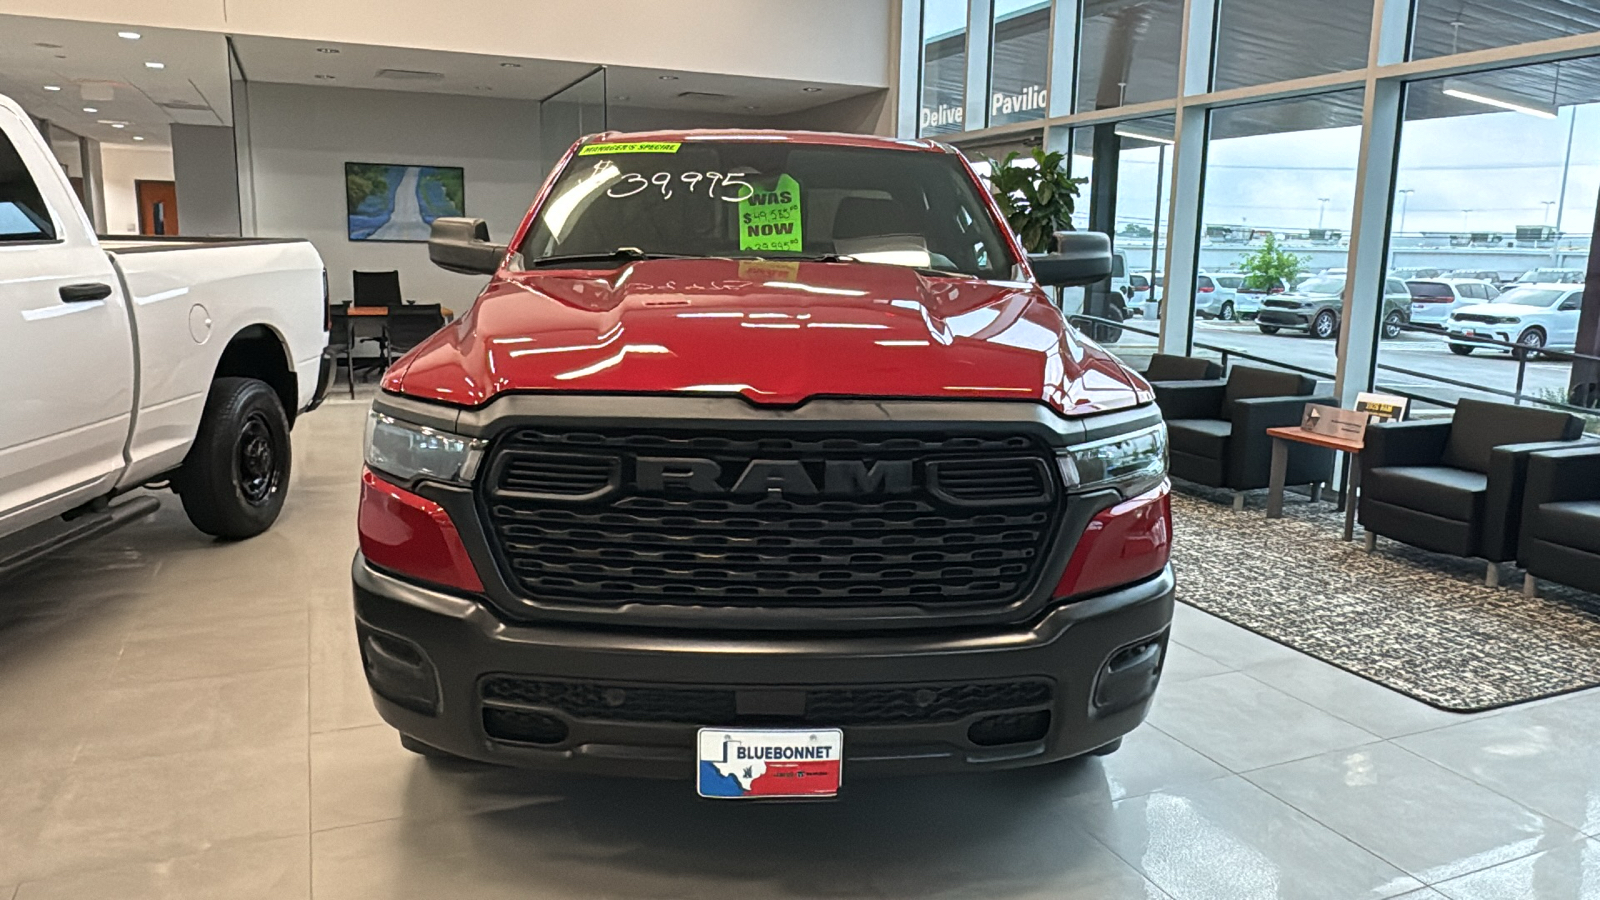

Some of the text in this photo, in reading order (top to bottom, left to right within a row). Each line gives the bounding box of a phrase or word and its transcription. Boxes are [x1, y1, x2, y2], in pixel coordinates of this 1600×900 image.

[583, 144, 637, 153] MANAGER'S
[748, 191, 792, 206] WAS
[747, 223, 794, 237] NOW
[636, 456, 912, 493] RAM
[737, 746, 832, 760] BLUEBONNET
